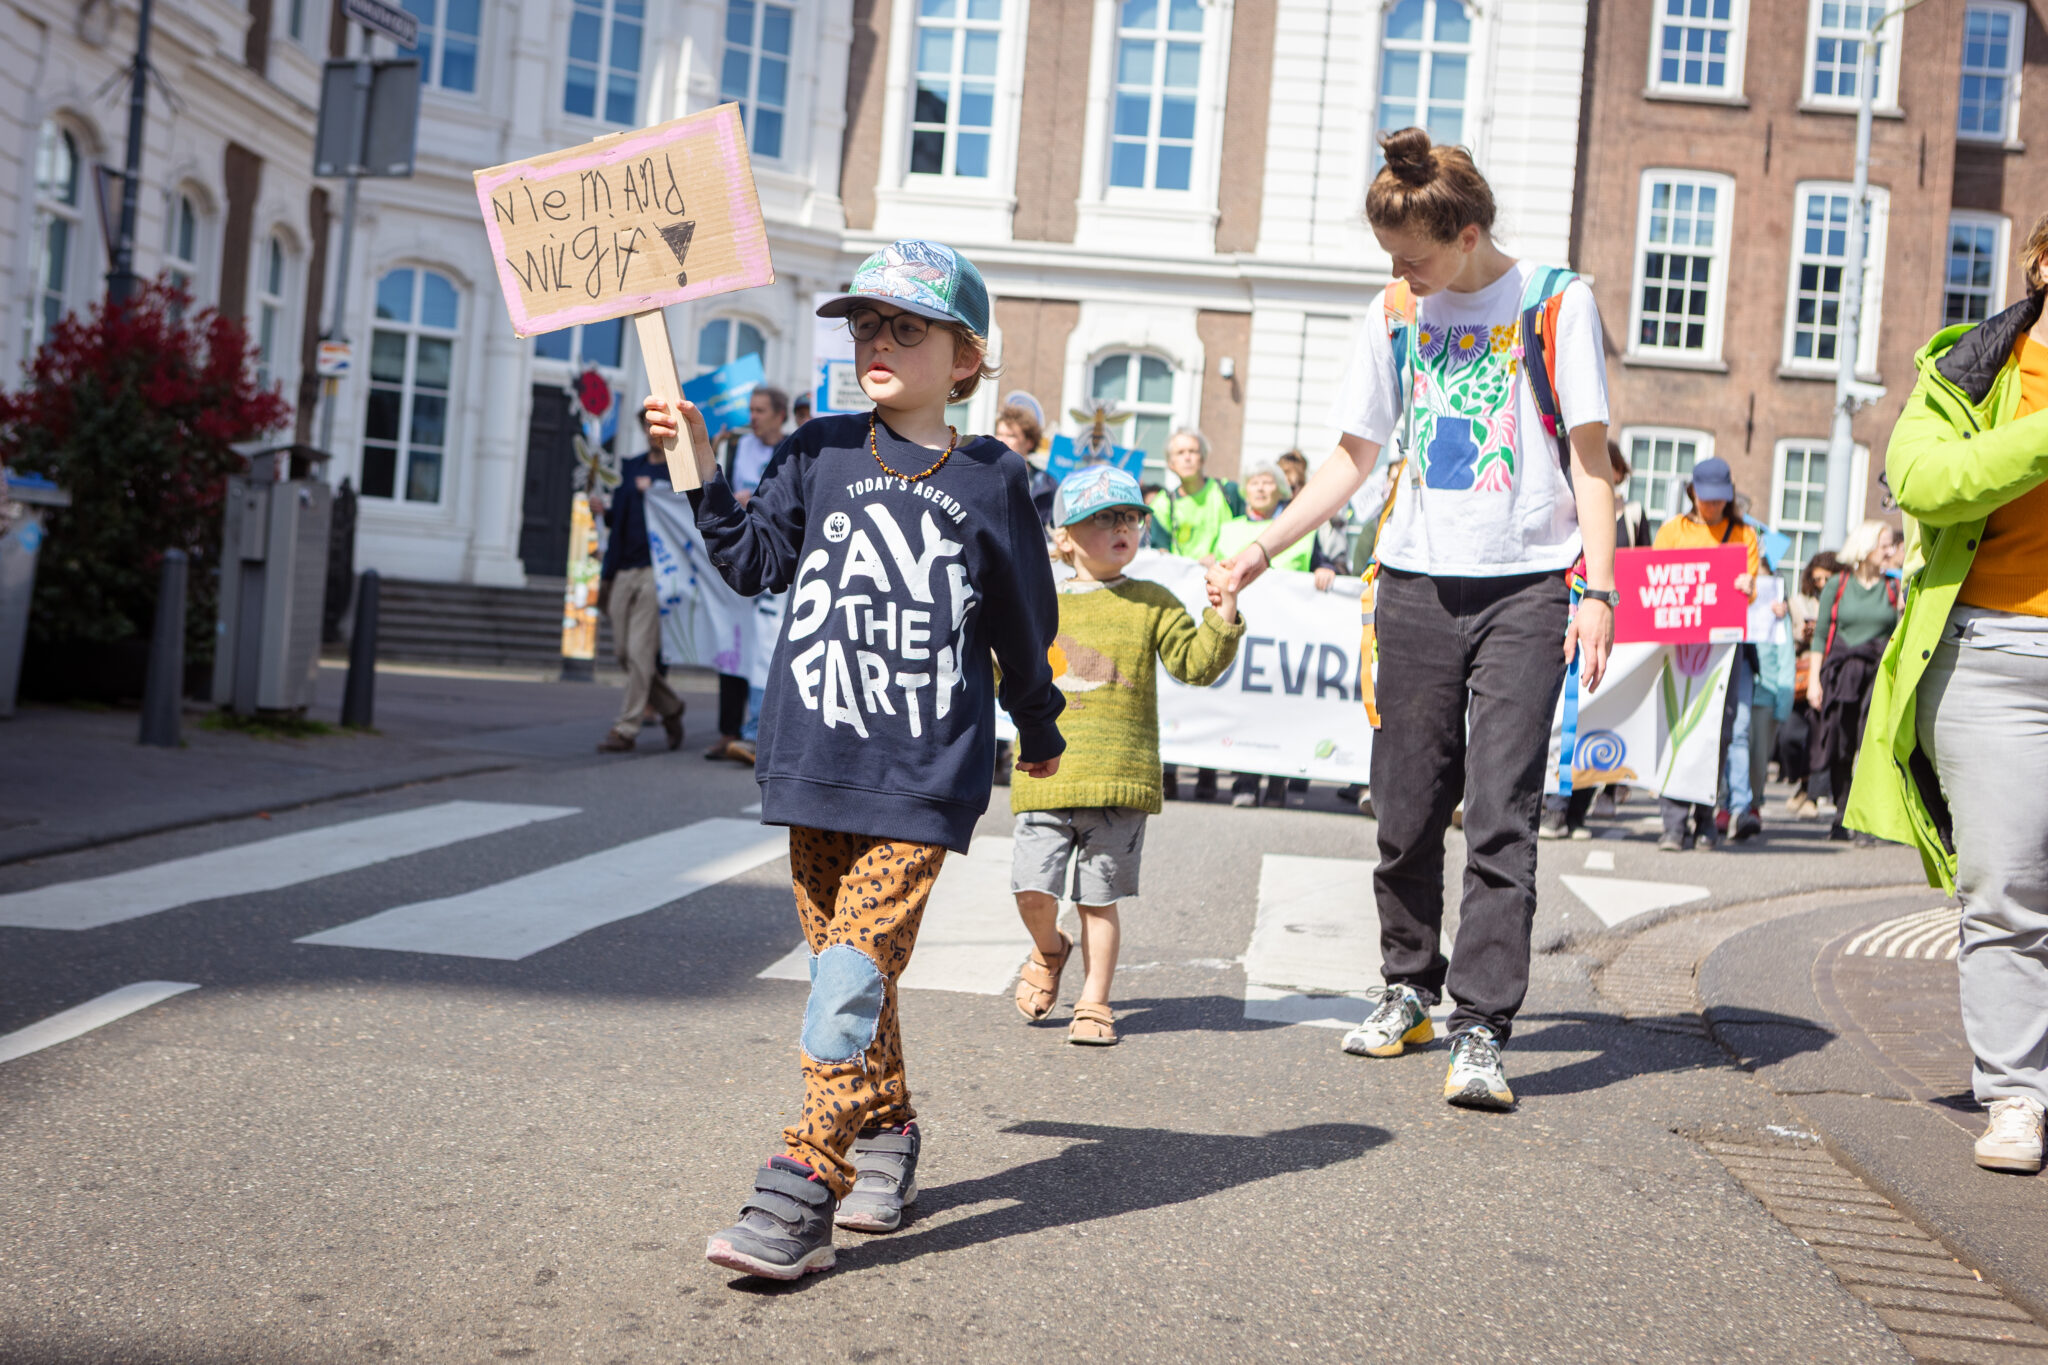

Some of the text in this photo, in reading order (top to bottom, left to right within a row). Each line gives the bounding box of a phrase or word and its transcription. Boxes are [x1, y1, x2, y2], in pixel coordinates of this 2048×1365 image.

[846, 476, 968, 525] TODAY'S AGENDA
[788, 503, 975, 641] SAVE
[1638, 582, 1718, 608] WAT JE
[1646, 562, 1711, 586] WEET
[835, 594, 931, 660] THE
[790, 617, 968, 738] EARTH
